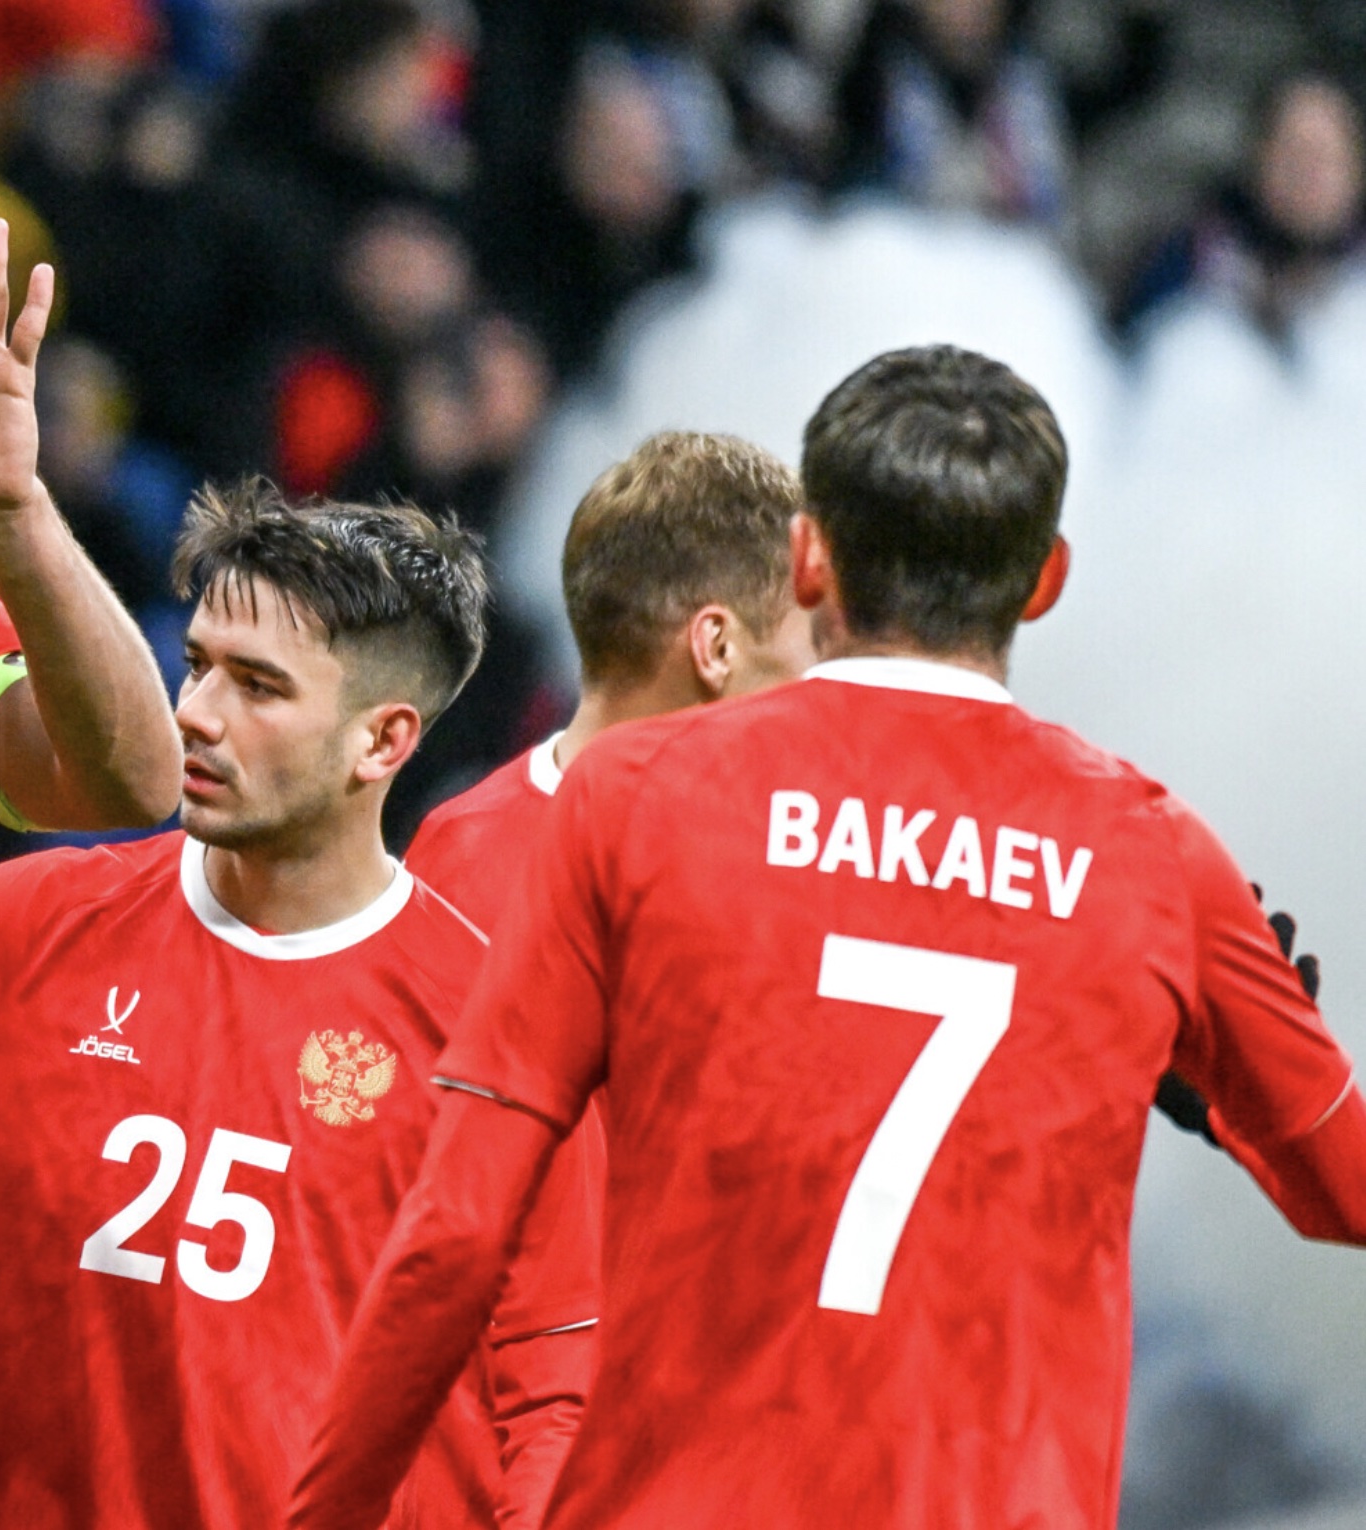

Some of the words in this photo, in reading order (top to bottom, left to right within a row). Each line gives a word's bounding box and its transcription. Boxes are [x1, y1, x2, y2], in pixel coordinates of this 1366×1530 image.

[766, 790, 1093, 919] BAKAEV
[69, 1035, 141, 1065] JÖGEL
[817, 932, 1018, 1316] 7
[79, 1114, 293, 1302] 25
